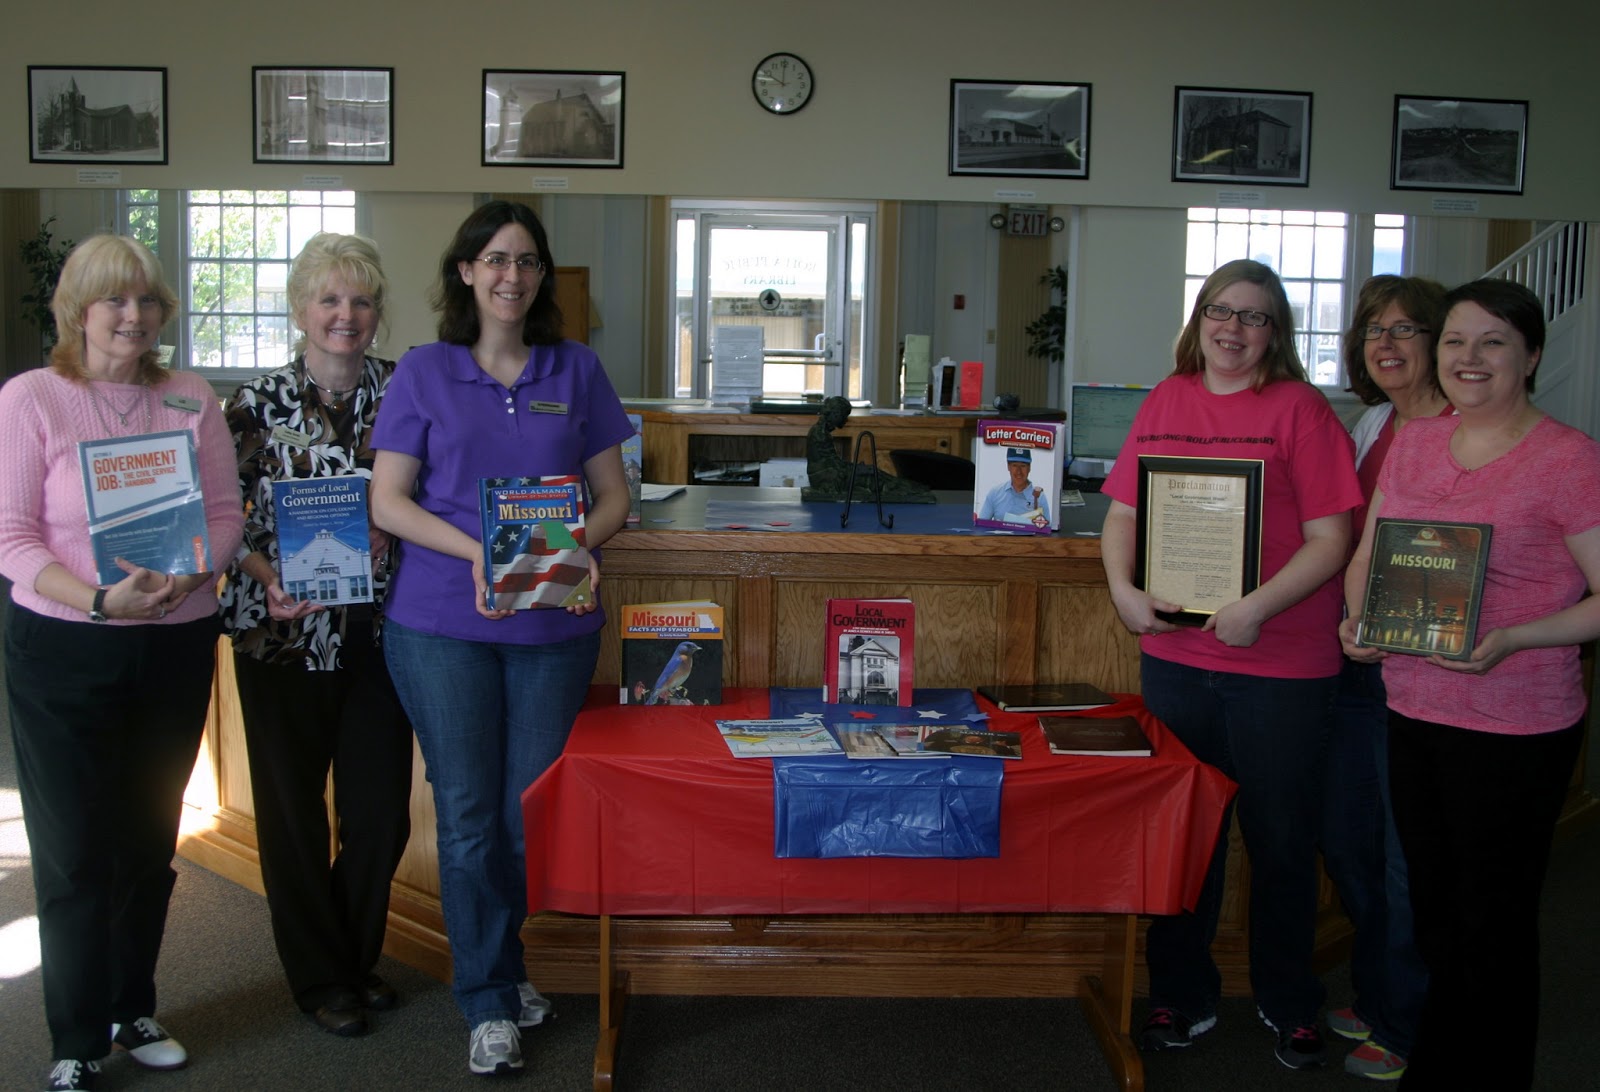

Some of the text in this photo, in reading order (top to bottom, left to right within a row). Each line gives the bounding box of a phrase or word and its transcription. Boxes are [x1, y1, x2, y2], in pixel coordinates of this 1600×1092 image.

[1012, 212, 1046, 234] EXIT
[986, 429, 1050, 444] Letter Carriers
[93, 450, 176, 474] GOVERNMENT
[136, 470, 151, 478] CIVIL
[152, 466, 176, 476] SERVICE
[96, 474, 122, 492] JOB:
[124, 477, 156, 488] HANDBOOK
[292, 482, 350, 495] Forms of Local
[1168, 478, 1230, 492] Proclamation
[282, 492, 360, 508] Government
[498, 502, 573, 520] Missouri
[1390, 554, 1456, 570] MISSOURI
[632, 610, 696, 627] Missouri
